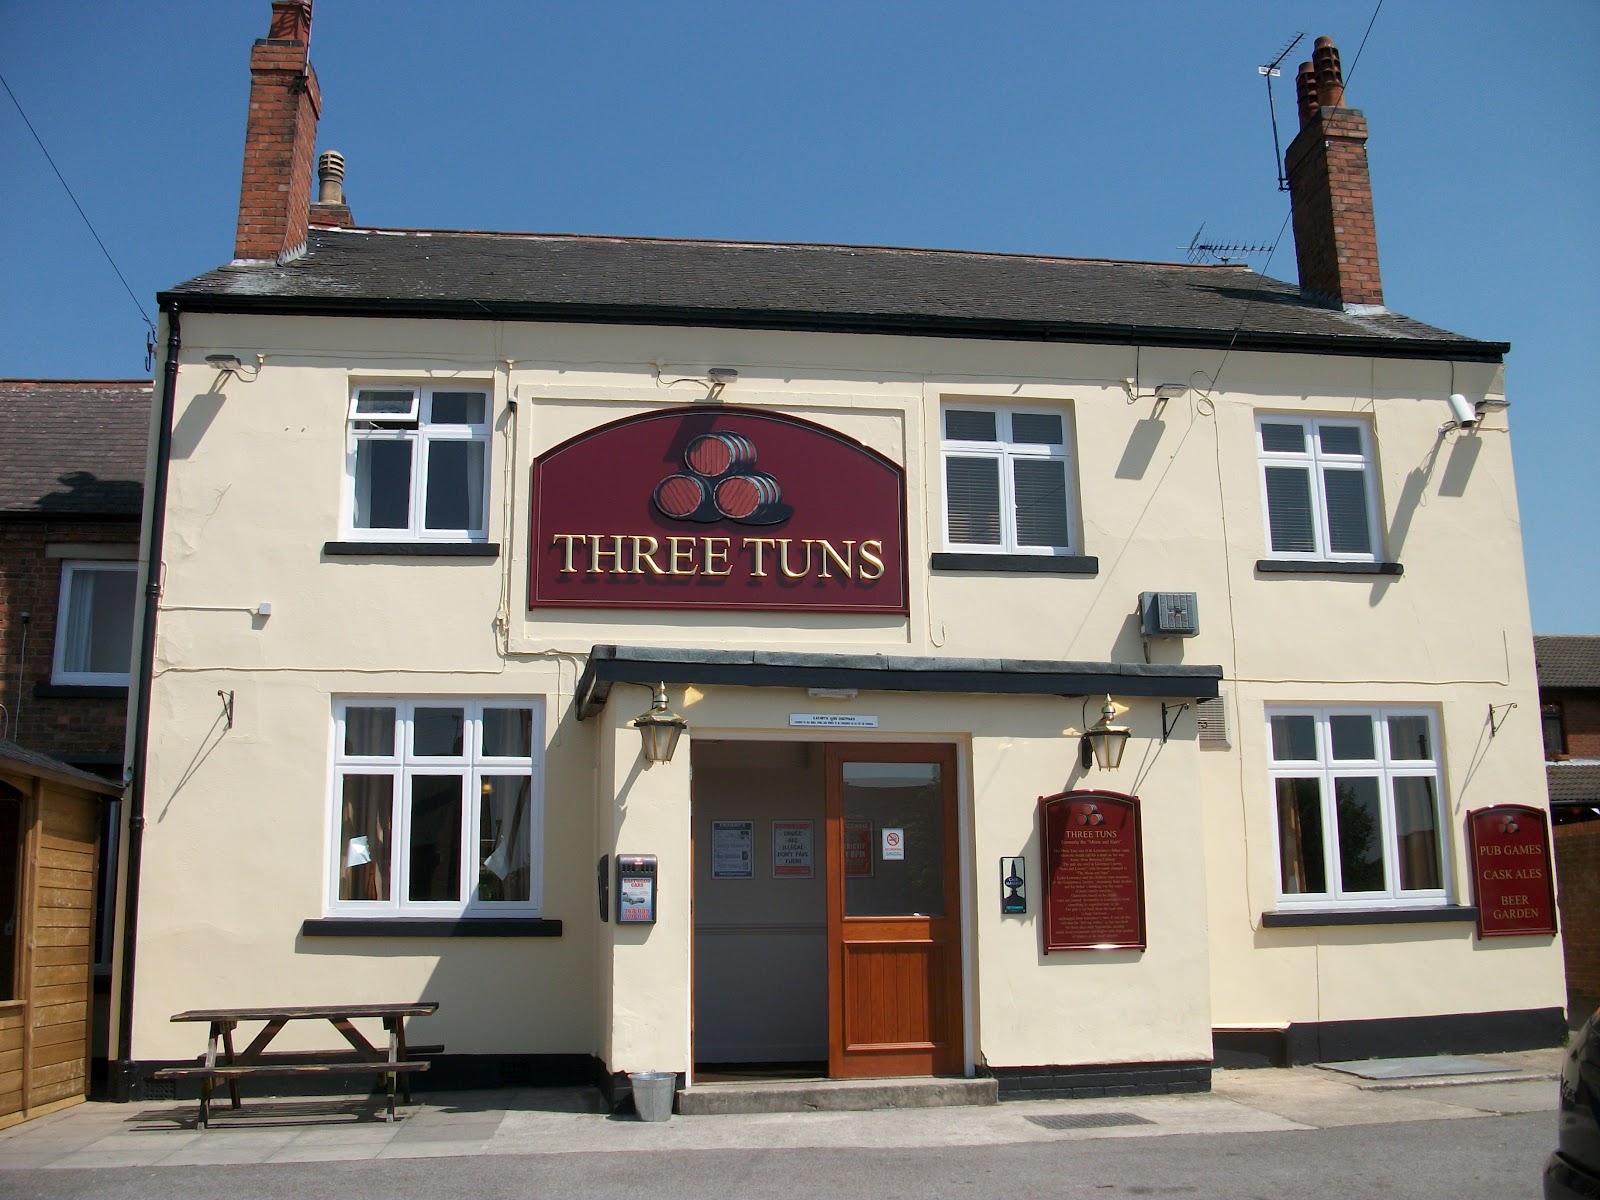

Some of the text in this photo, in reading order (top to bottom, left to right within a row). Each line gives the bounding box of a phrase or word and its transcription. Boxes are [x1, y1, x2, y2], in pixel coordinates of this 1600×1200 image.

[553, 534, 885, 580] THREE TUNS
[1065, 830, 1118, 838] THREE TUNS
[1480, 844, 1542, 856] PUB GAMES
[1483, 868, 1542, 880] CASK ALES
[1501, 895, 1529, 906] BEER
[1493, 908, 1539, 920] GARDEN
